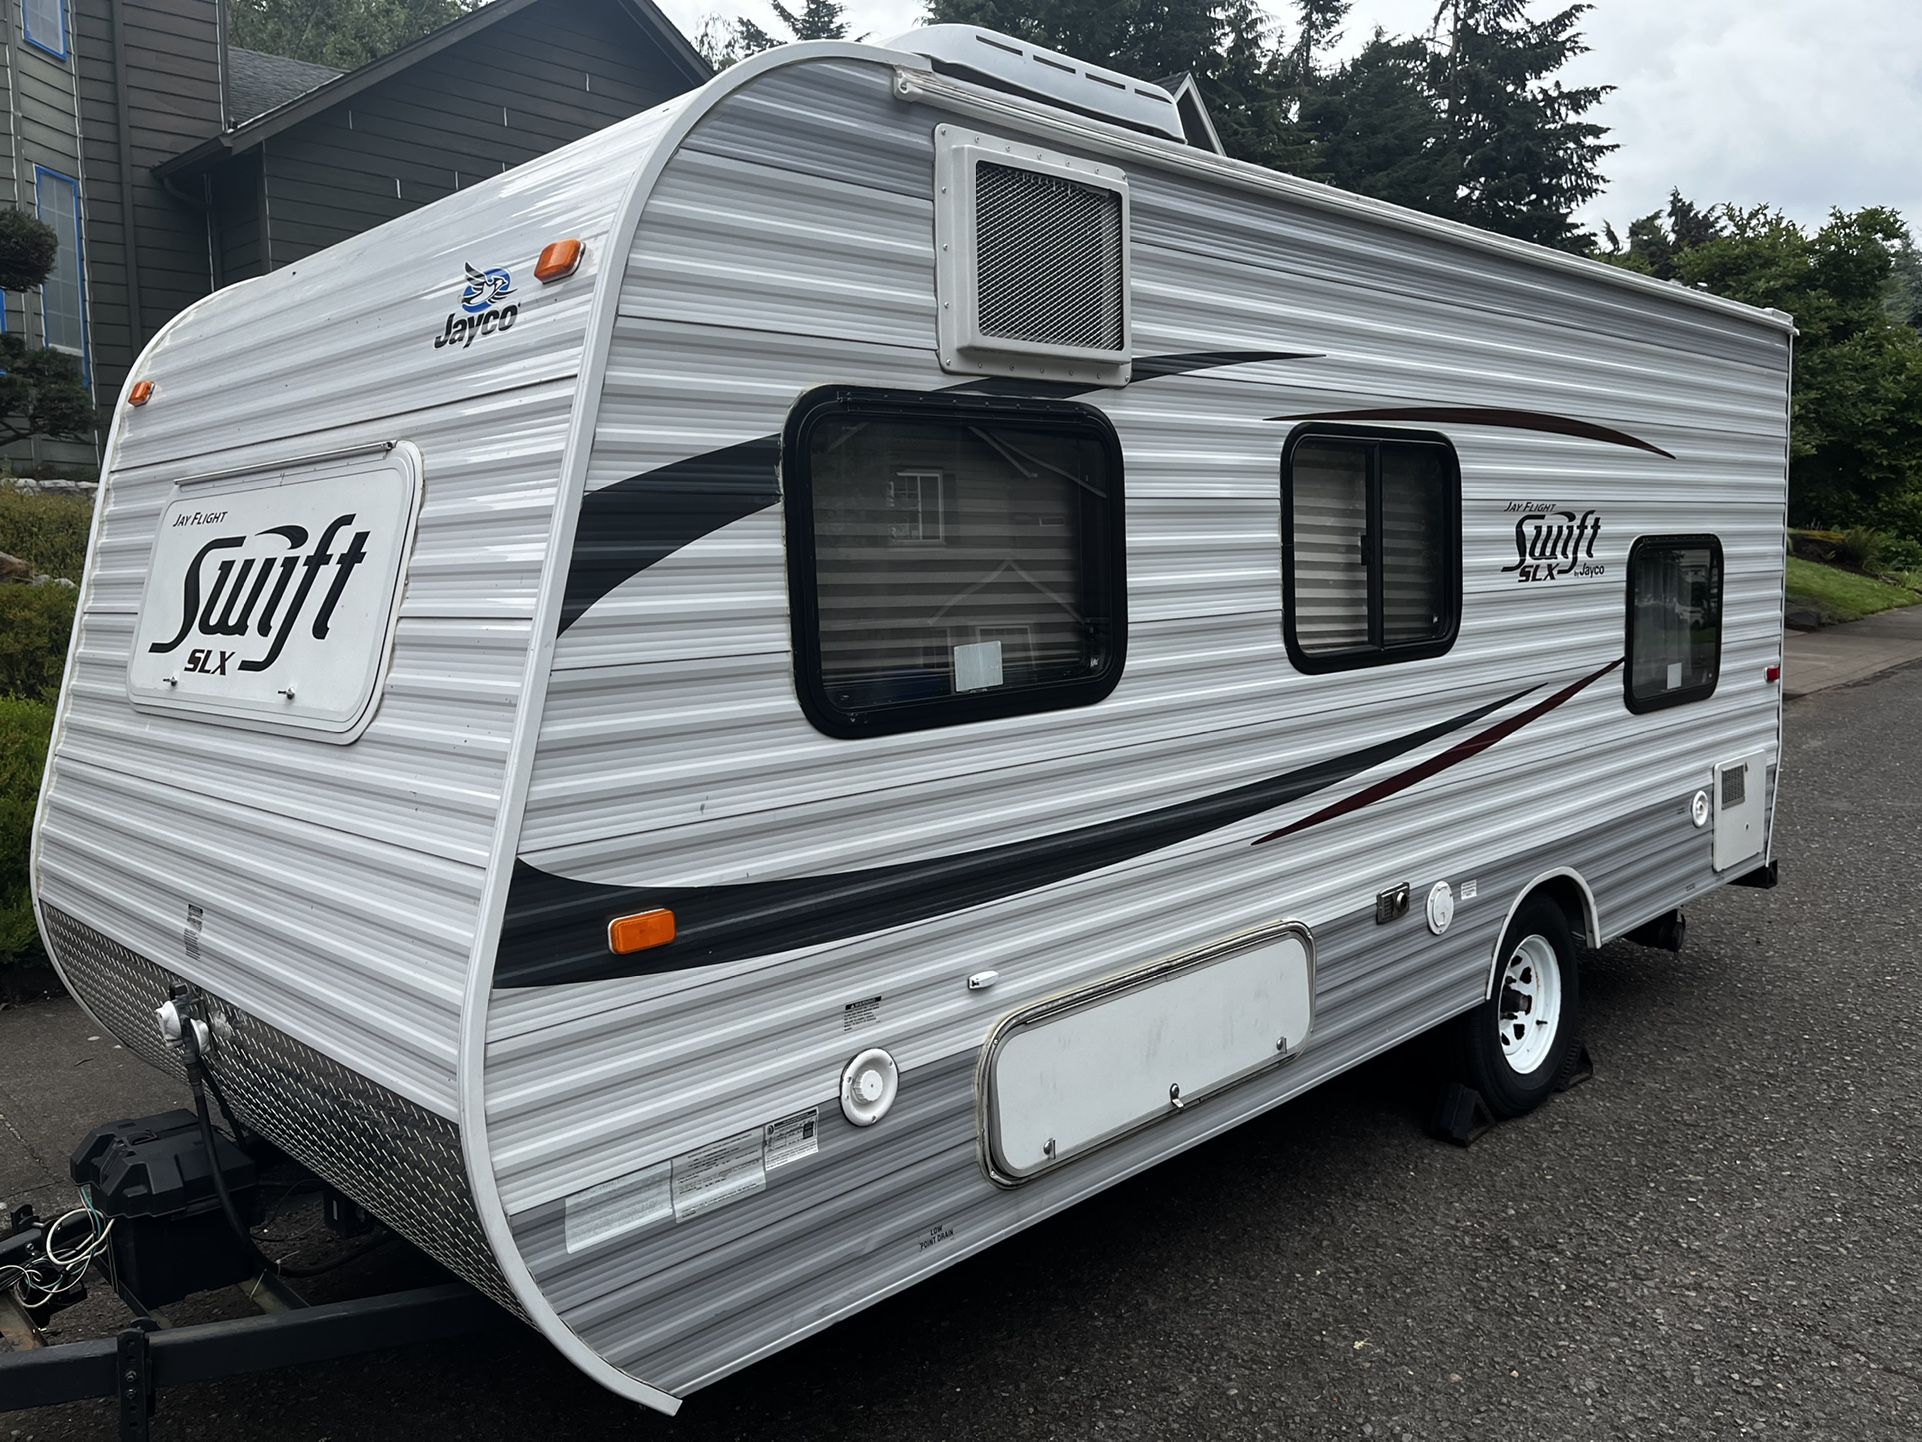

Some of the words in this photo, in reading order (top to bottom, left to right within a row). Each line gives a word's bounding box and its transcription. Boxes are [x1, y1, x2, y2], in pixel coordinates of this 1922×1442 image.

[434, 304, 519, 349] Jayco
[1503, 501, 1523, 512] JAY
[1522, 501, 1557, 512] FLIGHT
[172, 513, 192, 527] JAY
[190, 511, 228, 526] FLIGHT
[1500, 509, 1601, 575] Swift
[1518, 563, 1559, 583] SLX
[1580, 562, 1605, 578] Jayco
[148, 513, 371, 672] Swift
[184, 648, 236, 676] SLX
[919, 1236, 937, 1251] POINT
[937, 1229, 954, 1242] DRAIN
[930, 1224, 943, 1236] LOW
